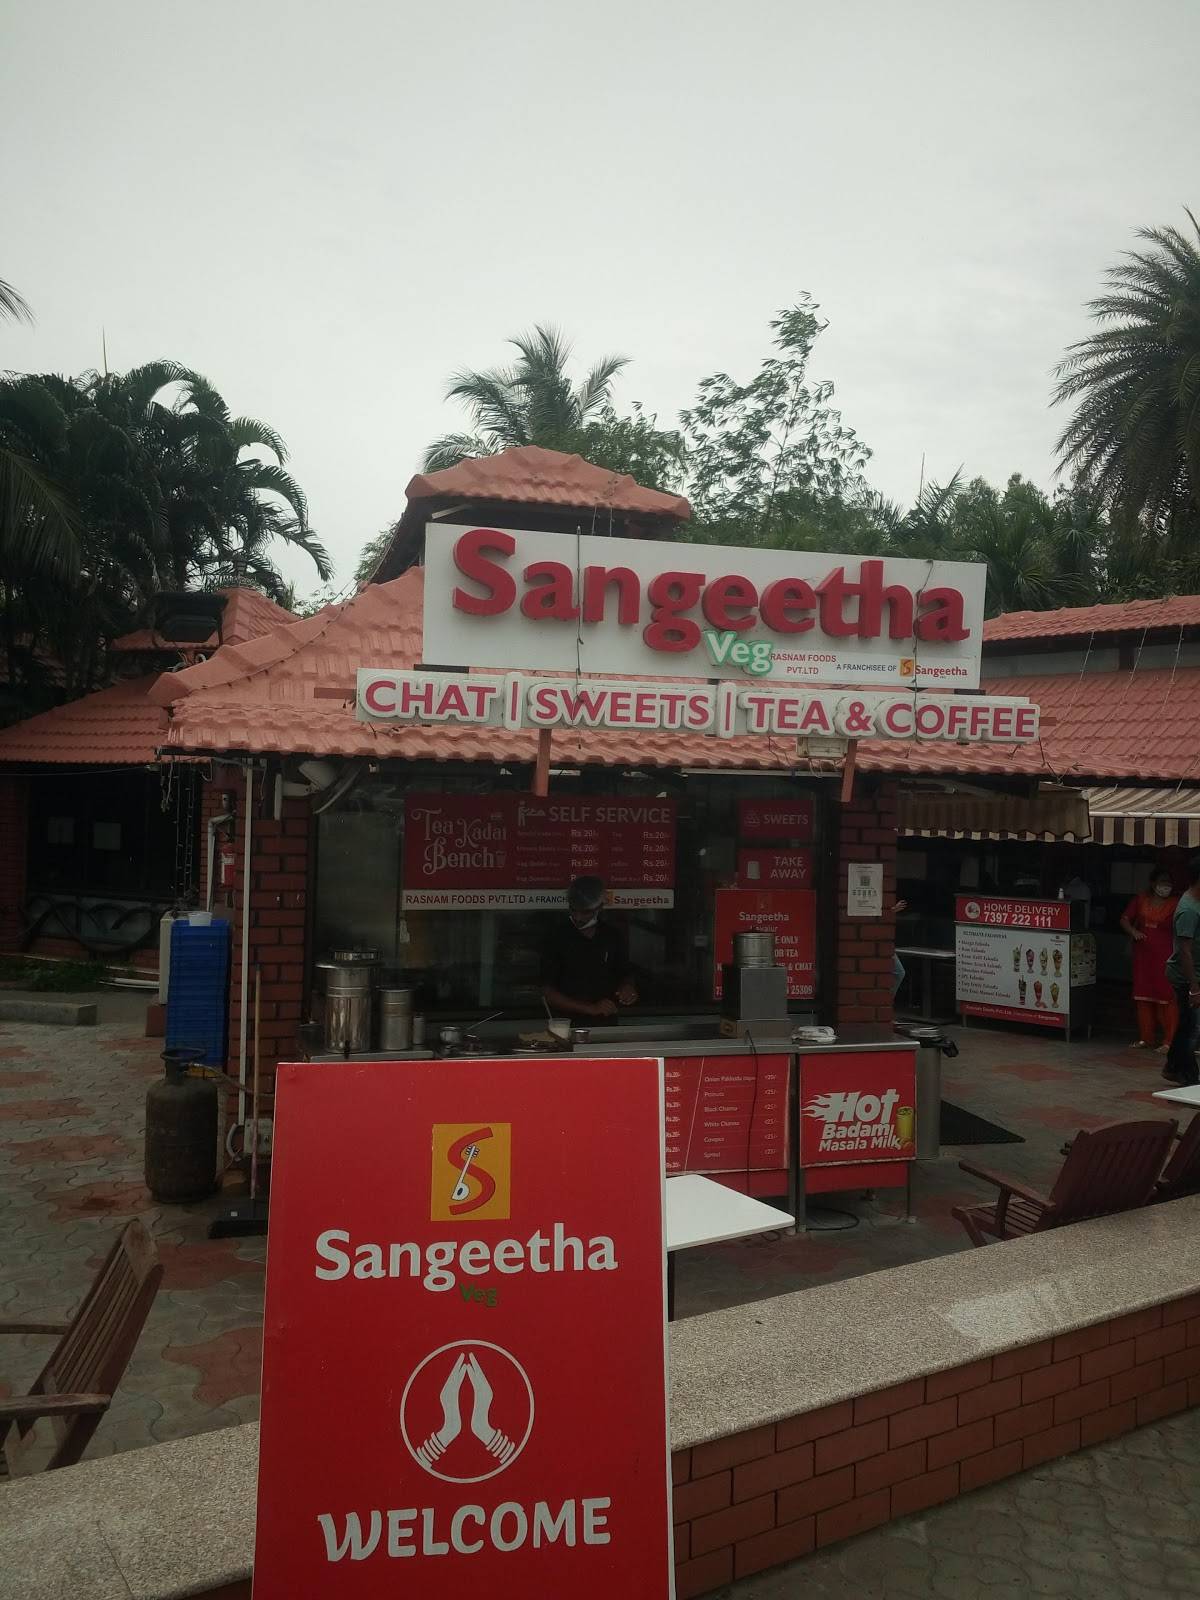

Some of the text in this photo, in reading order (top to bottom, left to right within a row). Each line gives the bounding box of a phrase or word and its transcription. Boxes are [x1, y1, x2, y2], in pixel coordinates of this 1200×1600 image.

[451, 529, 970, 654] Sangeetha
[704, 630, 773, 675] Veg
[771, 653, 837, 663] RASNAM FOODS
[836, 663, 842, 671] A
[842, 663, 886, 672] FRANCHISEE
[887, 665, 897, 673] OF
[914, 664, 968, 678] Sangeetha
[365, 680, 497, 718] CHAT
[535, 687, 709, 727] SWEETS
[748, 697, 831, 735] TEA
[848, 701, 873, 735] &
[885, 702, 1037, 741] COFFEE
[549, 806, 672, 824] SELF SERVICE
[763, 814, 809, 825] SWEETS
[411, 808, 454, 841] Tea
[423, 836, 495, 875] Bench
[775, 856, 803, 866] TAKE
[770, 868, 806, 879] AWAY
[406, 895, 449, 905] RASNAM
[451, 895, 486, 905] FOODS
[739, 911, 790, 924] Sangeetha
[983, 903, 1061, 917] HOME DELIVERY
[983, 912, 1052, 928] 7397 222 111
[822, 1089, 900, 1124] Hot
[819, 1125, 902, 1152] Masala Milk
[822, 1121, 890, 1139] Badam
[315, 1222, 619, 1292] Sangeetha
[458, 1283, 498, 1308] Veg
[317, 1496, 612, 1562] WELCOME
